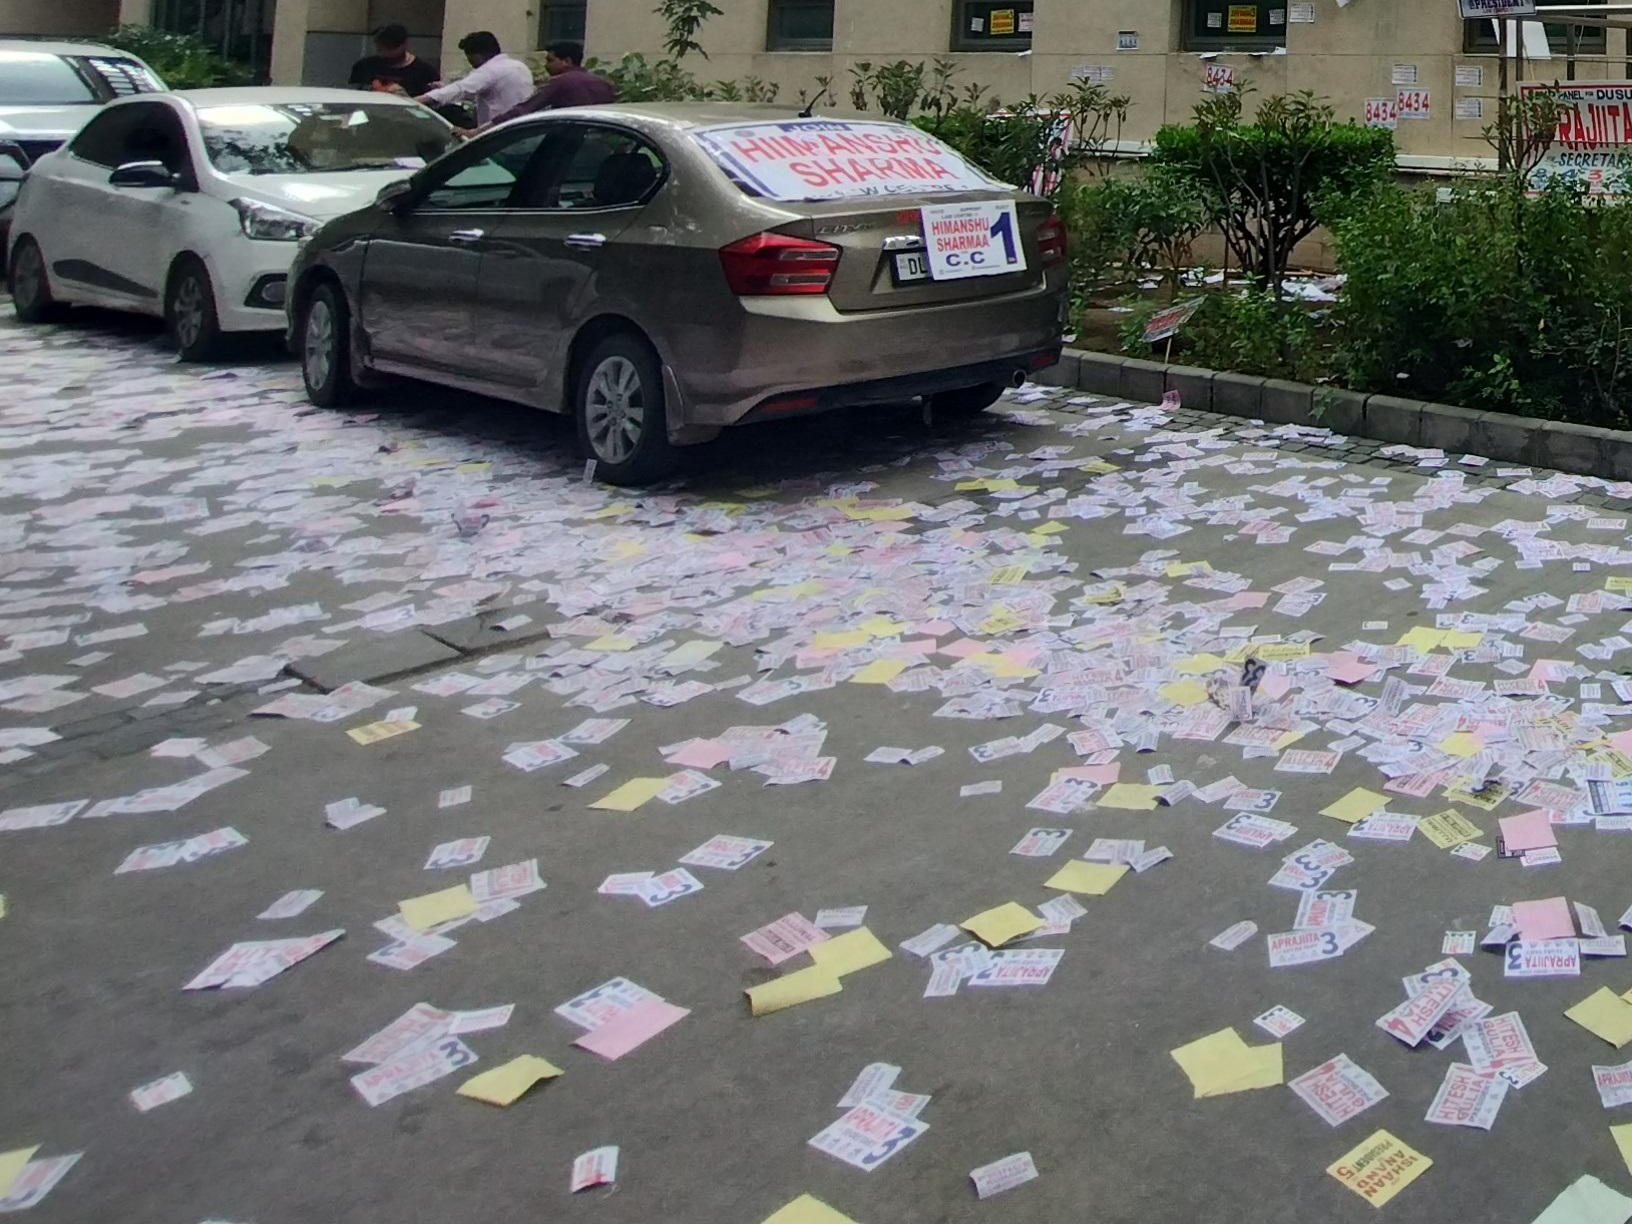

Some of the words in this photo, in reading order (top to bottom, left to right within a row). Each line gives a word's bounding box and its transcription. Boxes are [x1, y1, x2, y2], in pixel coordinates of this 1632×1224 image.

[1206, 66, 1234, 88] 8434
[1366, 102, 1397, 122] 8434
[1398, 92, 1429, 112] 8434
[788, 156, 961, 188] SHARMA
[931, 217, 989, 236] HIMANSHU
[936, 235, 990, 252] SHARMAA
[990, 212, 1018, 265] 1
[908, 256, 928, 276] DL
[945, 251, 985, 267] C.C
[1320, 931, 1339, 955] 3
[1508, 943, 1524, 971] 3
[1357, 1149, 1406, 1189] ANAND
[1364, 1155, 1419, 1198] ISHAAN
